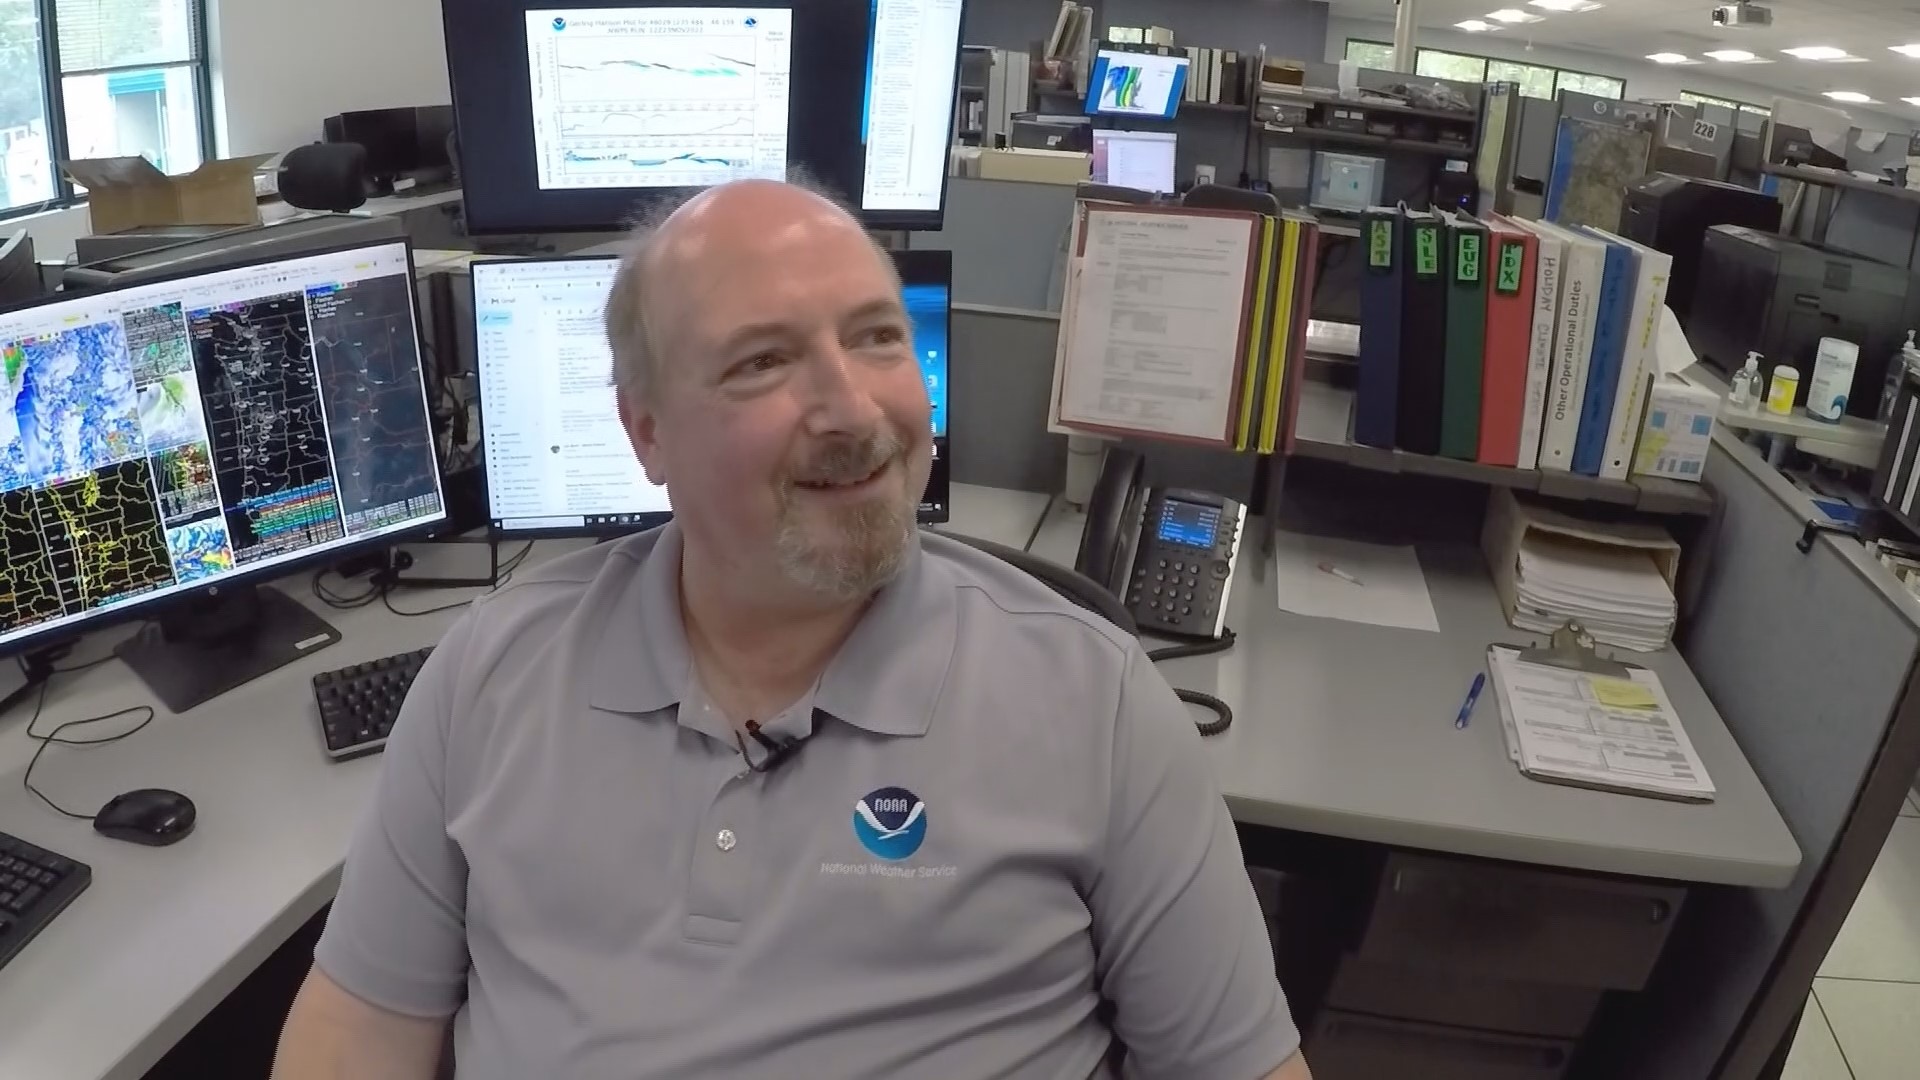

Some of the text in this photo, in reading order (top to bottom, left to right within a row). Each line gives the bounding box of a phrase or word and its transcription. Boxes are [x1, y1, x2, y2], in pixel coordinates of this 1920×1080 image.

[1694, 121, 1715, 138] 228
[1374, 220, 1390, 263] AST
[1421, 227, 1435, 269] SLE
[1462, 238, 1477, 277] EUG
[1540, 257, 1557, 312] HOLIDAY
[1568, 279, 1582, 317] Duties
[1559, 319, 1578, 387] Operational
[1555, 387, 1569, 421] Other
[874, 798, 908, 813] NOAA
[820, 862, 958, 879] National Weather Service
